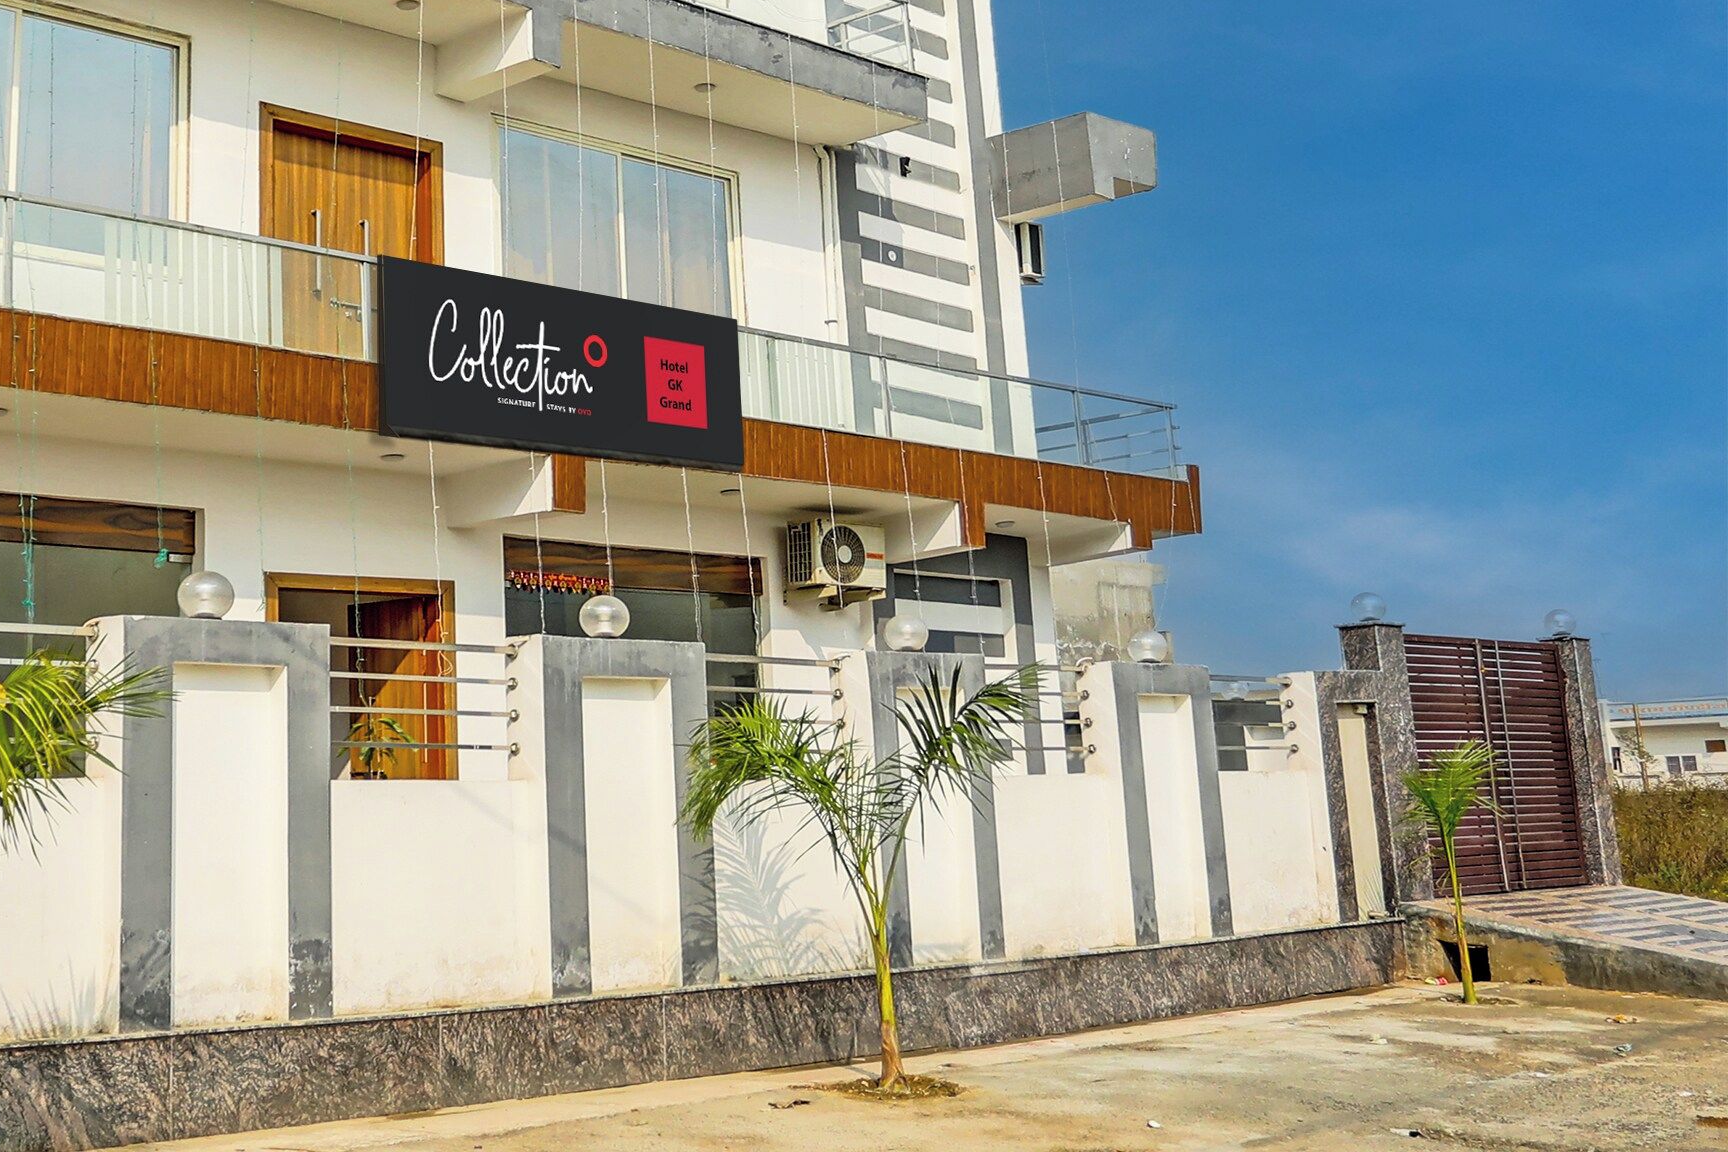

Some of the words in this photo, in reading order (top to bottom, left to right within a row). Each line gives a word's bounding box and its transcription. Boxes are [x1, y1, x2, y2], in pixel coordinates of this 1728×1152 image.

[429, 299, 594, 411] Collection
[660, 358, 688, 374] Hotel
[668, 378, 683, 392] GK
[546, 403, 566, 413] STAYS
[568, 406, 576, 414] BY
[659, 396, 692, 411] Grand
